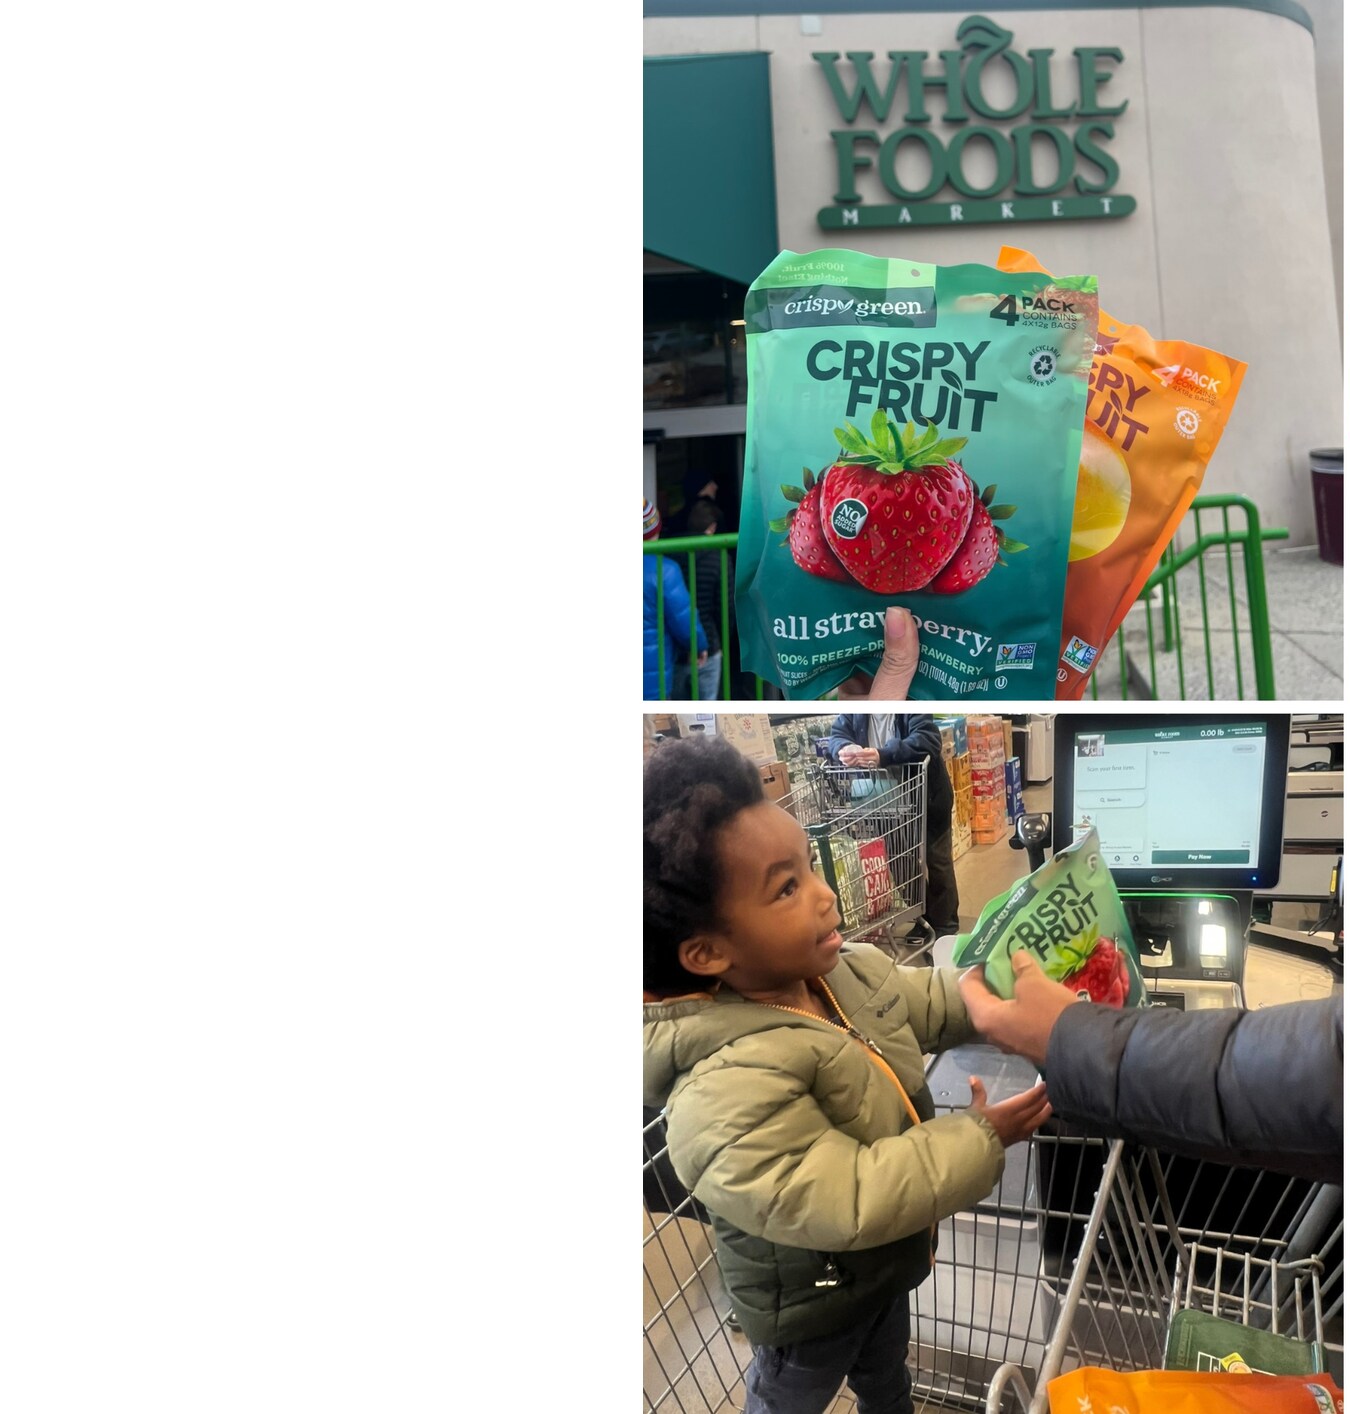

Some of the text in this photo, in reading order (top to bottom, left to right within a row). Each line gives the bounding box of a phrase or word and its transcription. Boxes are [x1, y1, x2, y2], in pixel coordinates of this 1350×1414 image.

[811, 47, 1129, 123] WHOLE
[830, 121, 1120, 203] FOODS
[842, 198, 1113, 225] MARKET
[989, 294, 1075, 327] 4 PACK
[1022, 311, 1078, 322] CONTAINS
[1051, 321, 1077, 330] BAGS
[806, 339, 992, 382] CRISPY
[1028, 344, 1061, 359] RECYCLABLE
[1026, 374, 1057, 387] OUTER BAG
[1176, 379, 1217, 400] CONTAINS
[1183, 368, 1221, 393] PACK
[846, 374, 998, 432] FRUIT
[839, 503, 861, 522] NO
[773, 615, 810, 640] all
[777, 652, 809, 666] 100%
[1031, 891, 1099, 962] FRUIT
